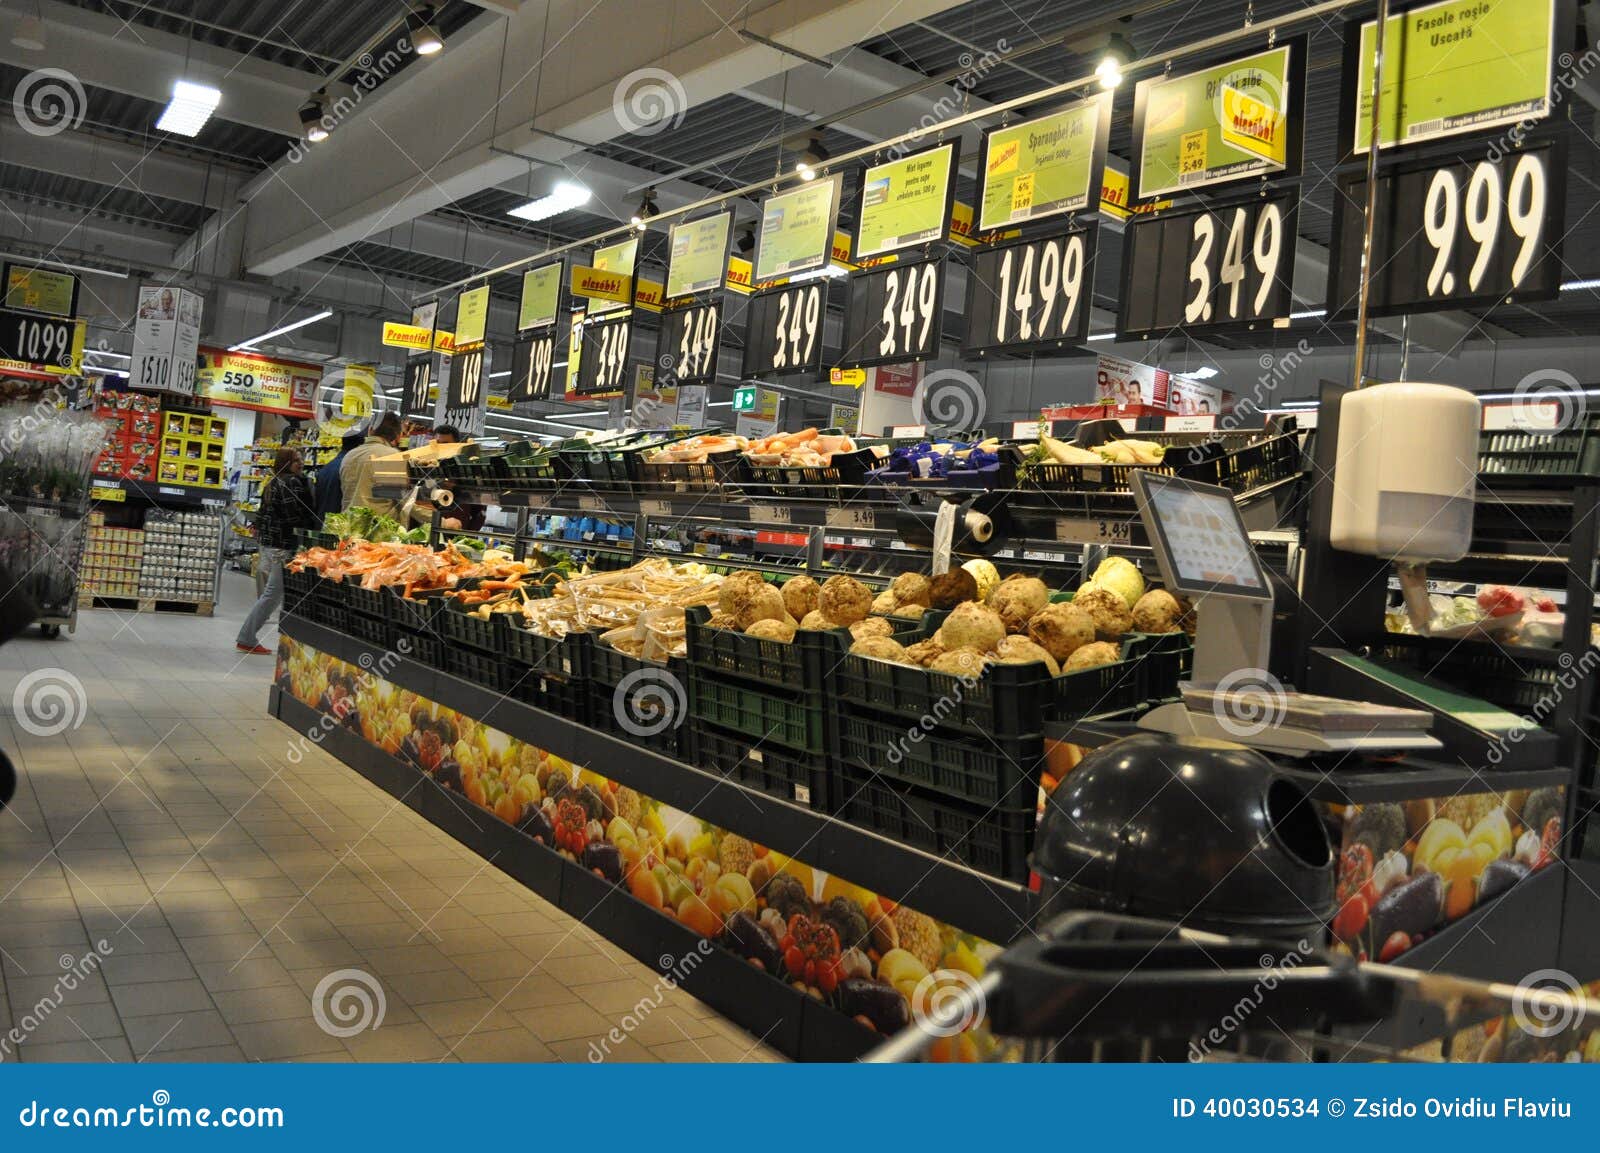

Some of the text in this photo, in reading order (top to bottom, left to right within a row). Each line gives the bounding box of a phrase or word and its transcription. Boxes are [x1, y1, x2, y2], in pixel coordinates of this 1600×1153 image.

[1416, 13, 1455, 33] Fasole
[1424, 154, 1546, 296] 9.99
[1185, 203, 1281, 323] 3.49
[223, 371, 254, 388] 550
[261, 382, 289, 394] hazai
[773, 507, 790, 519] 3.99
[854, 511, 873, 522] 3.49
[1100, 520, 1129, 538] 3.49
